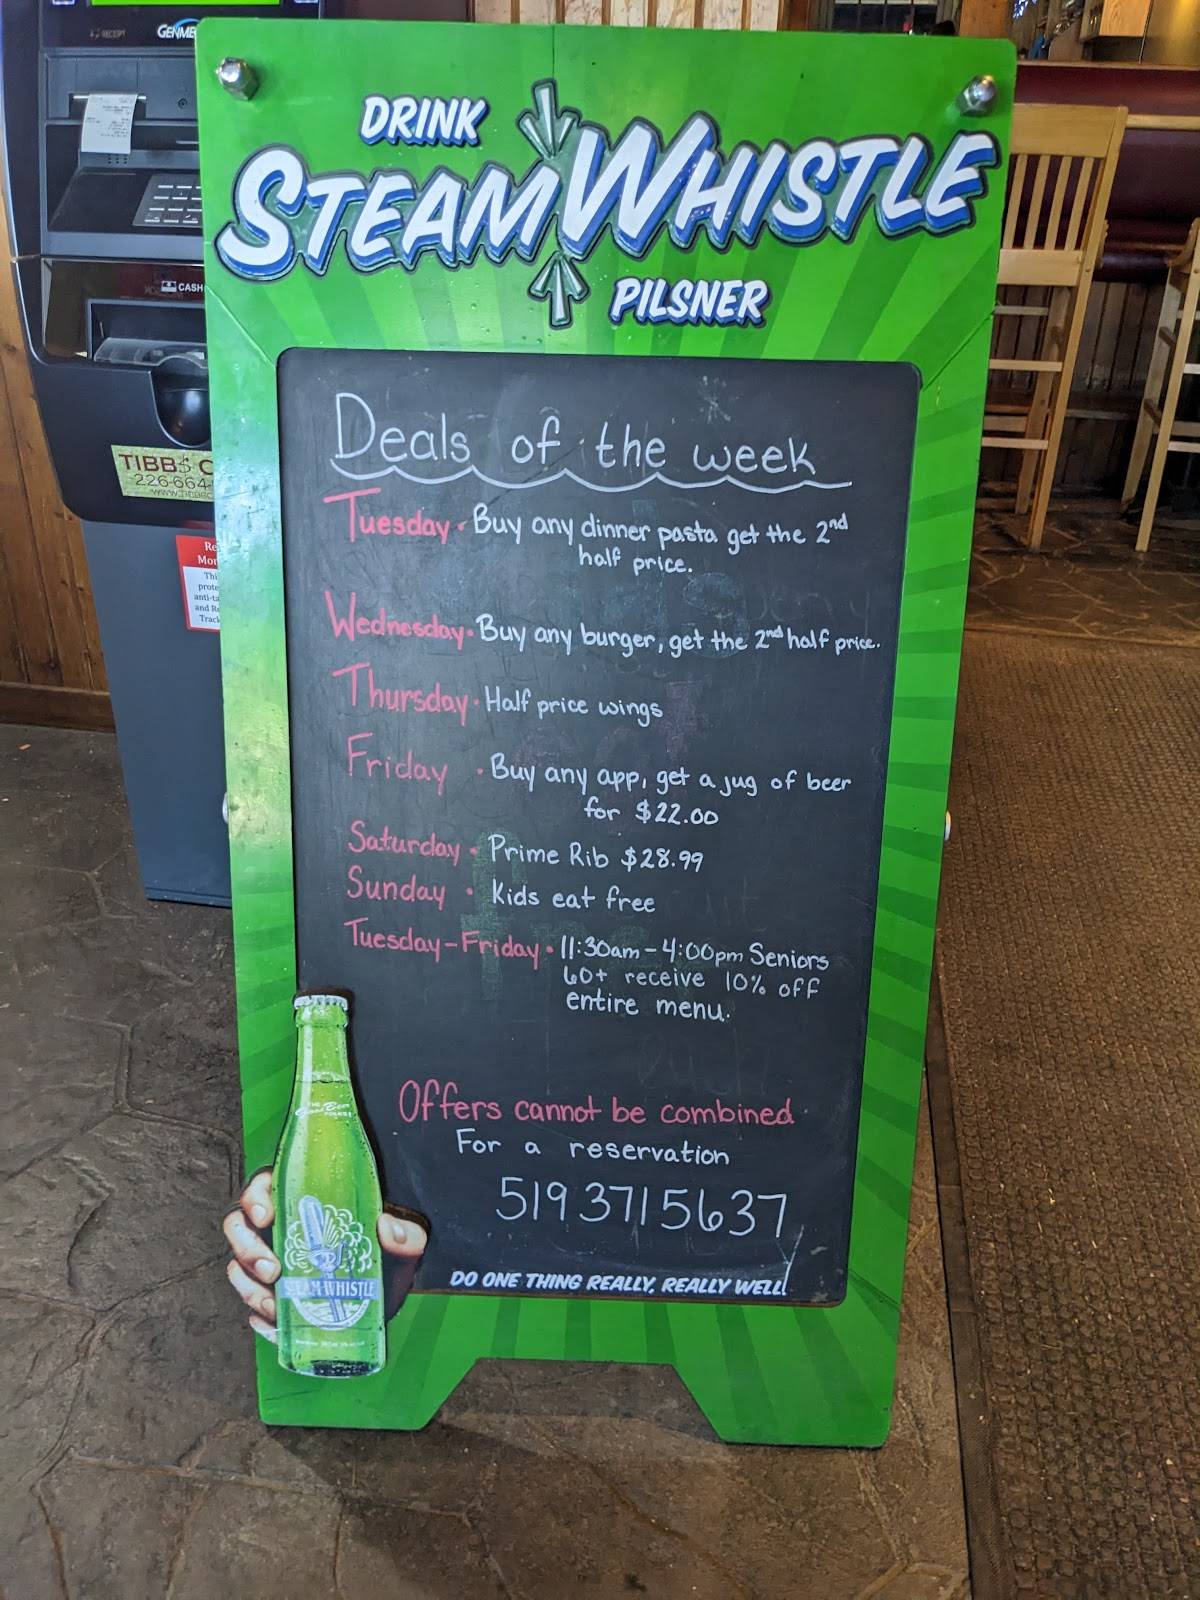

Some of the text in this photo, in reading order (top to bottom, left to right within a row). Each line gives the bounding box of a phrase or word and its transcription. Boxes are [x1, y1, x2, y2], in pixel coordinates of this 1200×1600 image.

[157, 24, 197, 39] GENME
[361, 96, 488, 145] DRINK
[216, 113, 995, 276] STEAM WHISTLE
[178, 283, 203, 292] CASH
[610, 278, 768, 326] PILSNER
[335, 393, 815, 475] Deals of the week
[323, 487, 848, 554] Tuesday Buy any dinner pasta get the 2nd
[578, 544, 693, 575] half price.
[324, 590, 881, 658] Wednesday Buy any burger, get the 2nd half price.
[332, 661, 664, 727] Thursday Half price wings
[347, 731, 852, 797] Friday Buy any app, get a jug of beer
[583, 796, 720, 826] for $22.00
[348, 820, 704, 873] Saturday Prime Rib $28.99
[347, 865, 656, 912] Sunday Kids eat free
[749, 942, 829, 971] Seniors
[563, 966, 820, 999] 60+ receive 10% off
[566, 989, 731, 1021] entire menu.
[399, 1079, 795, 1125] Offers cannot be combined
[456, 1128, 730, 1165] For a reservation
[450, 1270, 477, 1287] DO
[482, 1272, 521, 1288] ONE
[526, 1273, 582, 1290] THING
[586, 1274, 656, 1293] REALLY,
[661, 1278, 732, 1294] REALLY
